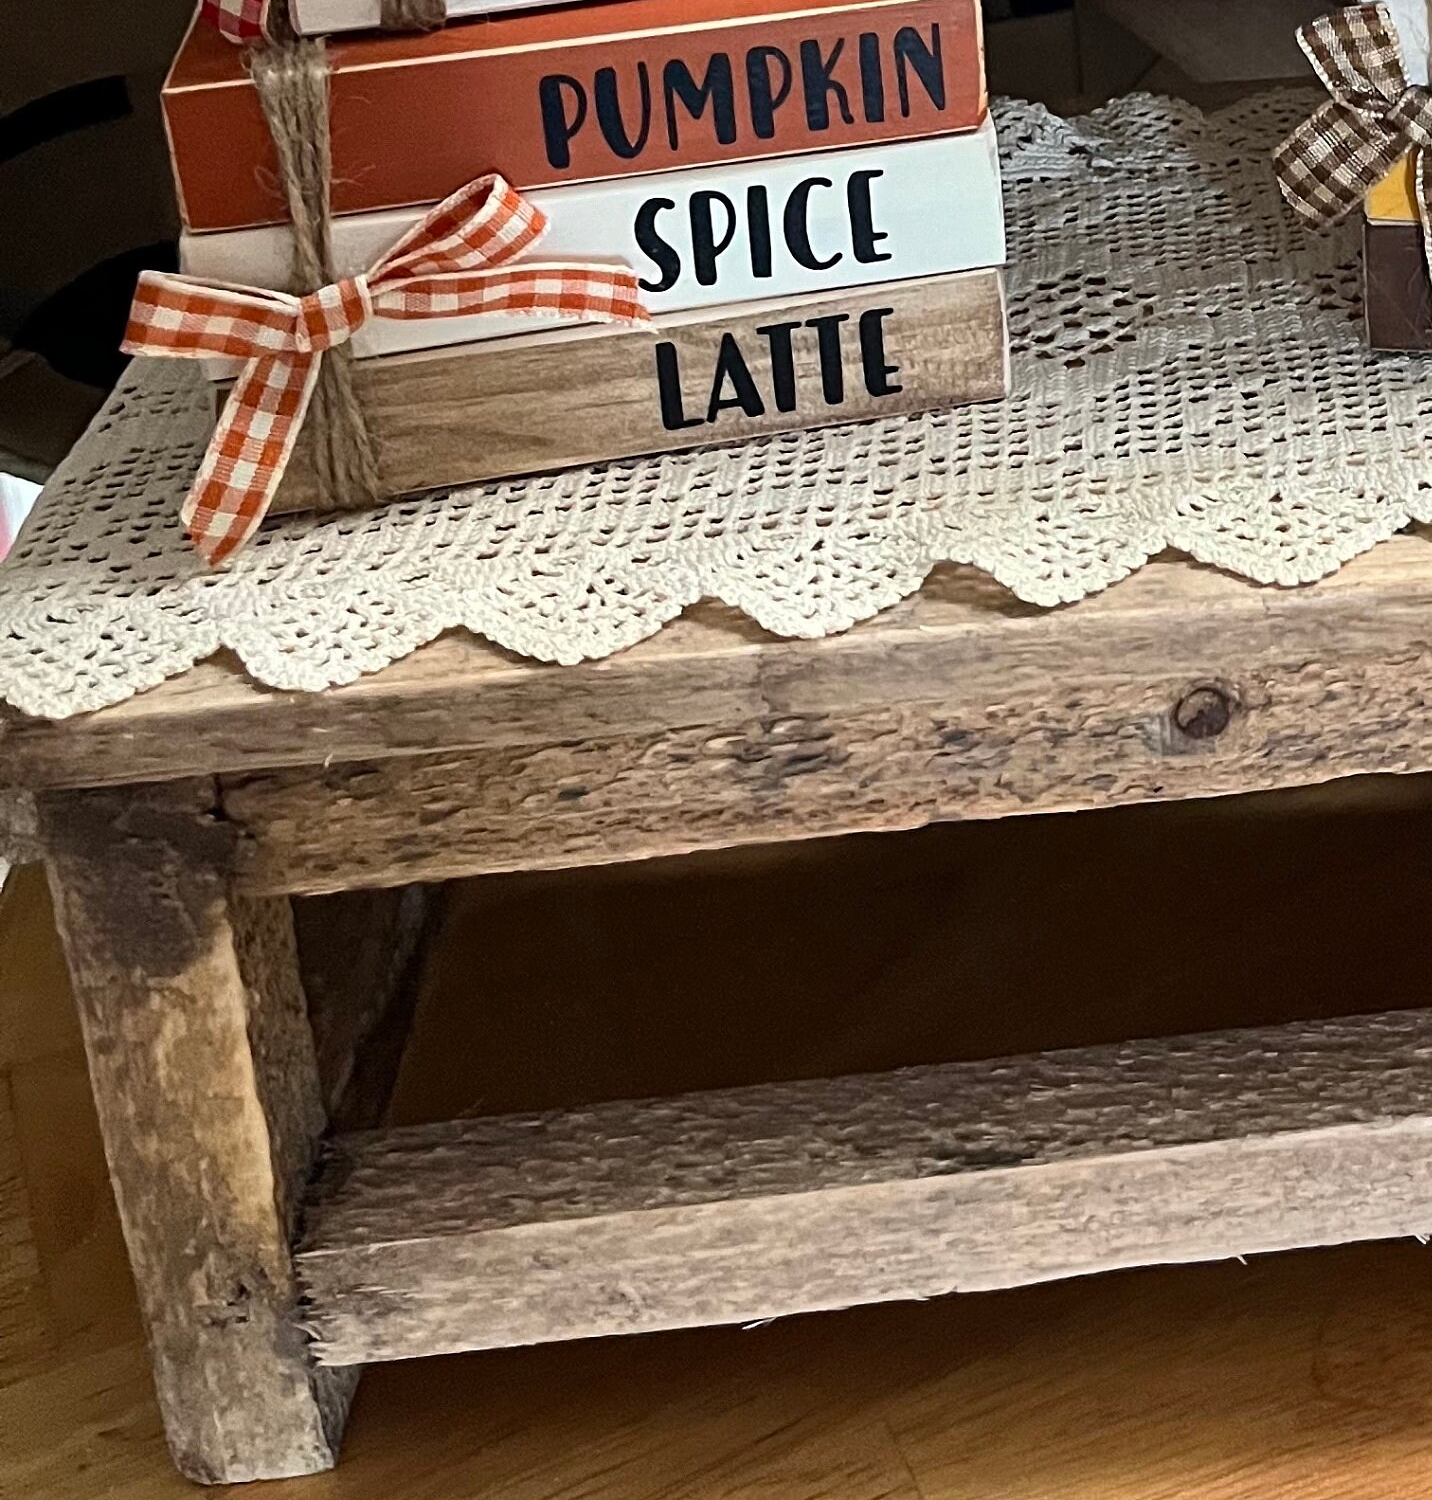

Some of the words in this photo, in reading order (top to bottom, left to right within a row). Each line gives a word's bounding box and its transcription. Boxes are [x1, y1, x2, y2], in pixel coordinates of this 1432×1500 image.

[538, 22, 947, 170] PUMPKIN
[633, 169, 893, 293] SPICE
[654, 307, 904, 432] LATTE
